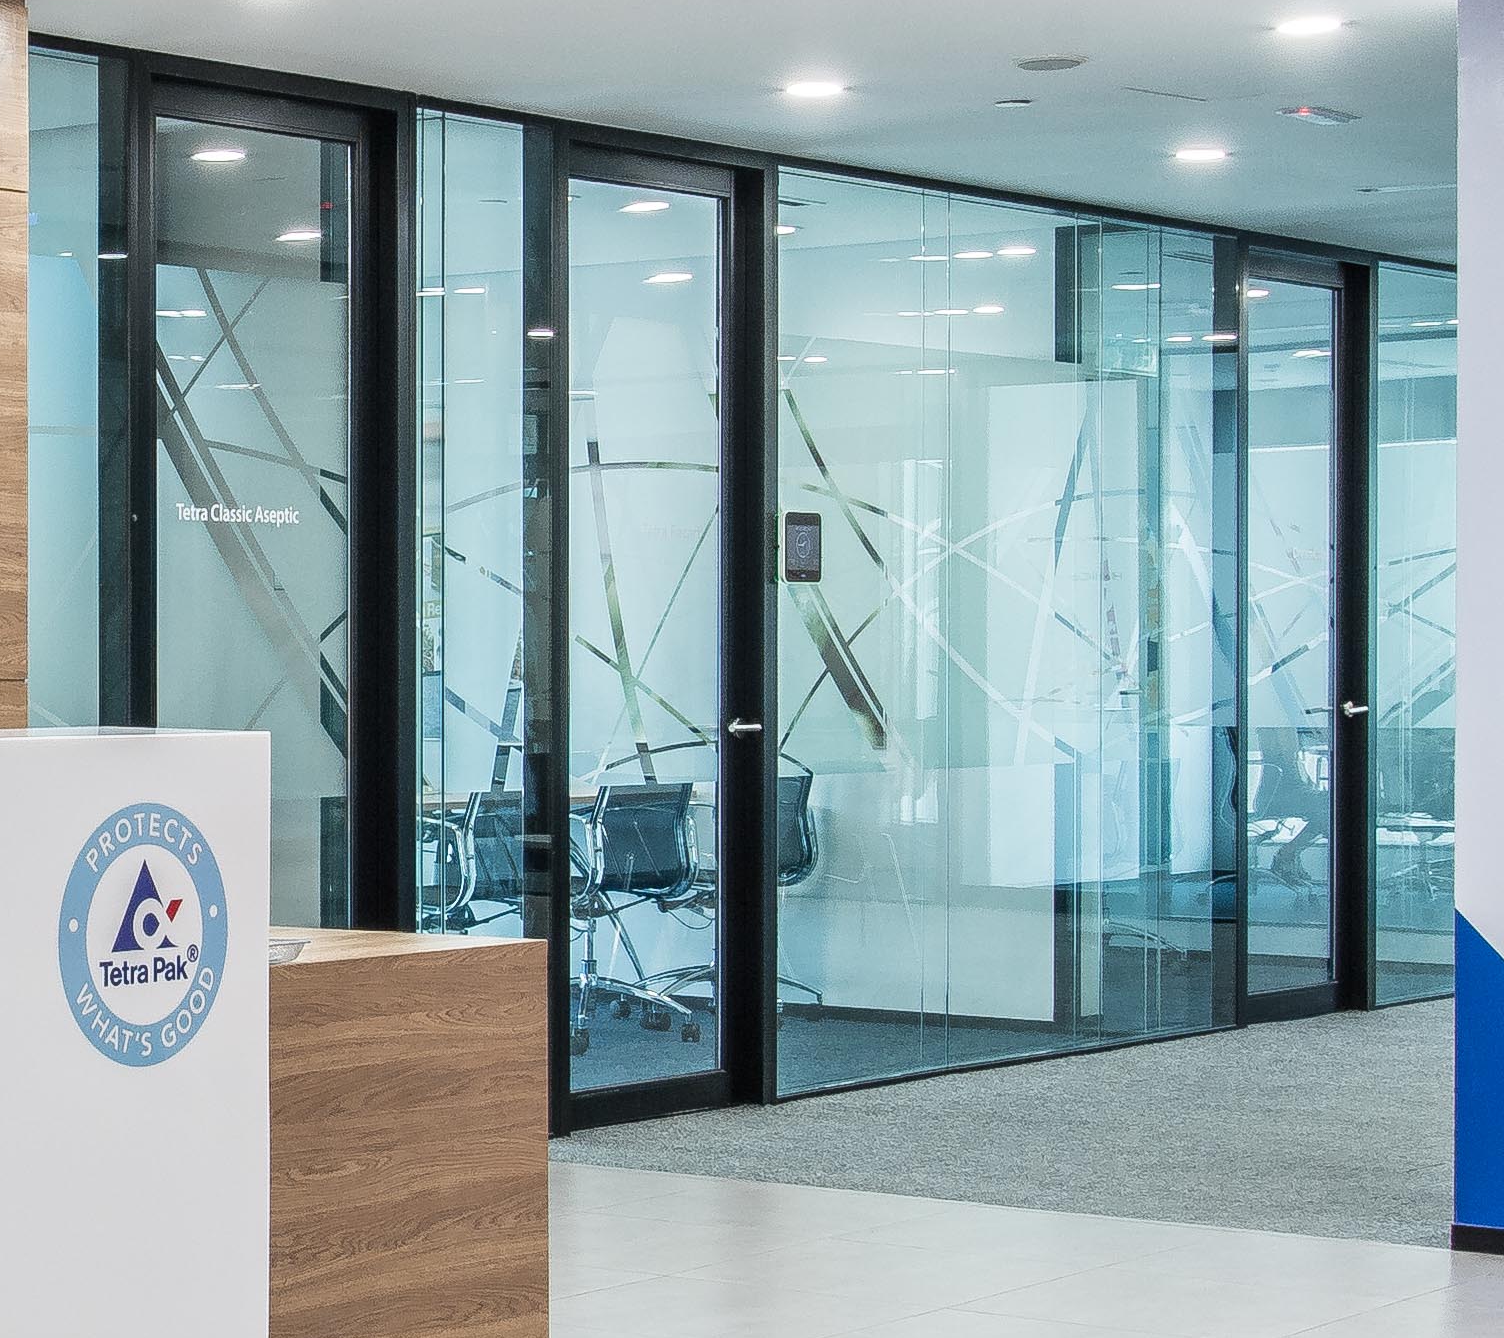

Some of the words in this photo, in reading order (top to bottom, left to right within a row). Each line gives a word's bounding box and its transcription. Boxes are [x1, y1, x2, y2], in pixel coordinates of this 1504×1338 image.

[176, 503, 208, 521] Tetra
[210, 503, 253, 522] Classic
[254, 506, 300, 528] Aseptic
[85, 812, 203, 873] PROTECTS
[99, 961, 149, 987] Tetra
[76, 982, 153, 1057] WHAT'S
[161, 966, 215, 1049] GOOD
